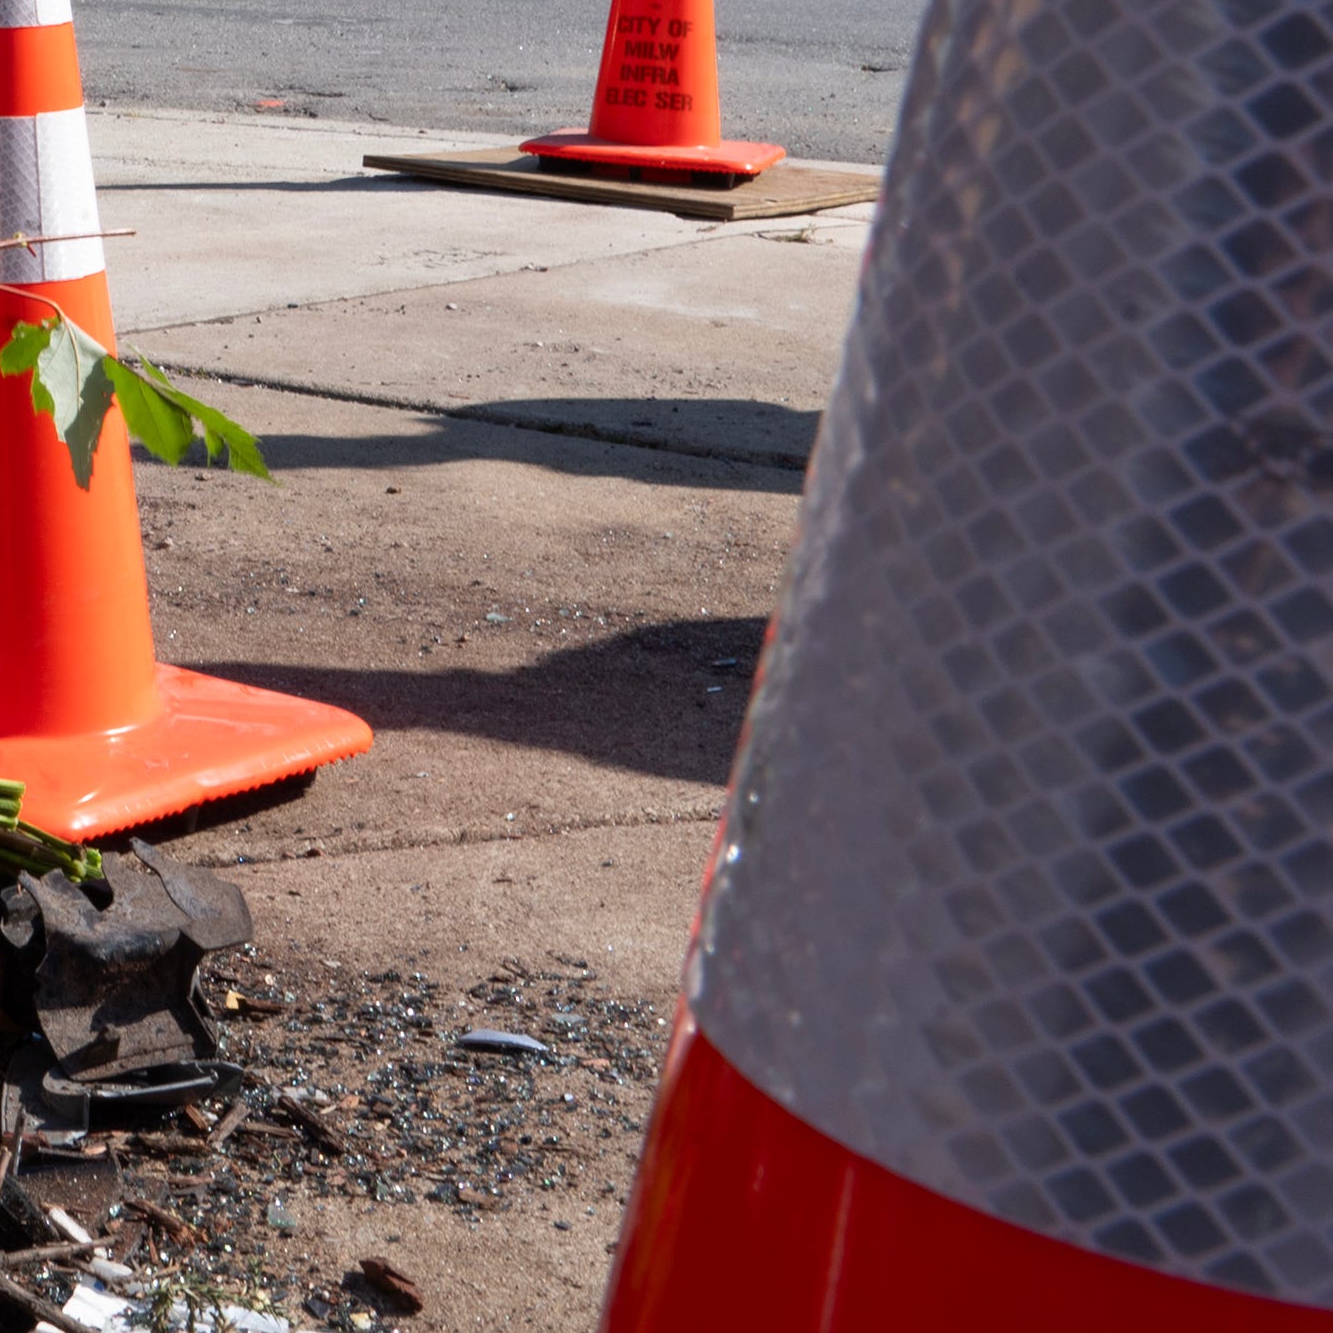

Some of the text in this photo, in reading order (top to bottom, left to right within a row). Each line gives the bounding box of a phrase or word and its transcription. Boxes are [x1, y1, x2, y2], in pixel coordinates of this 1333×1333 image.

[618, 15, 693, 38] CITY OF
[624, 39, 680, 62] MILW
[620, 63, 680, 86] INFRA
[605, 87, 648, 107] ELEC
